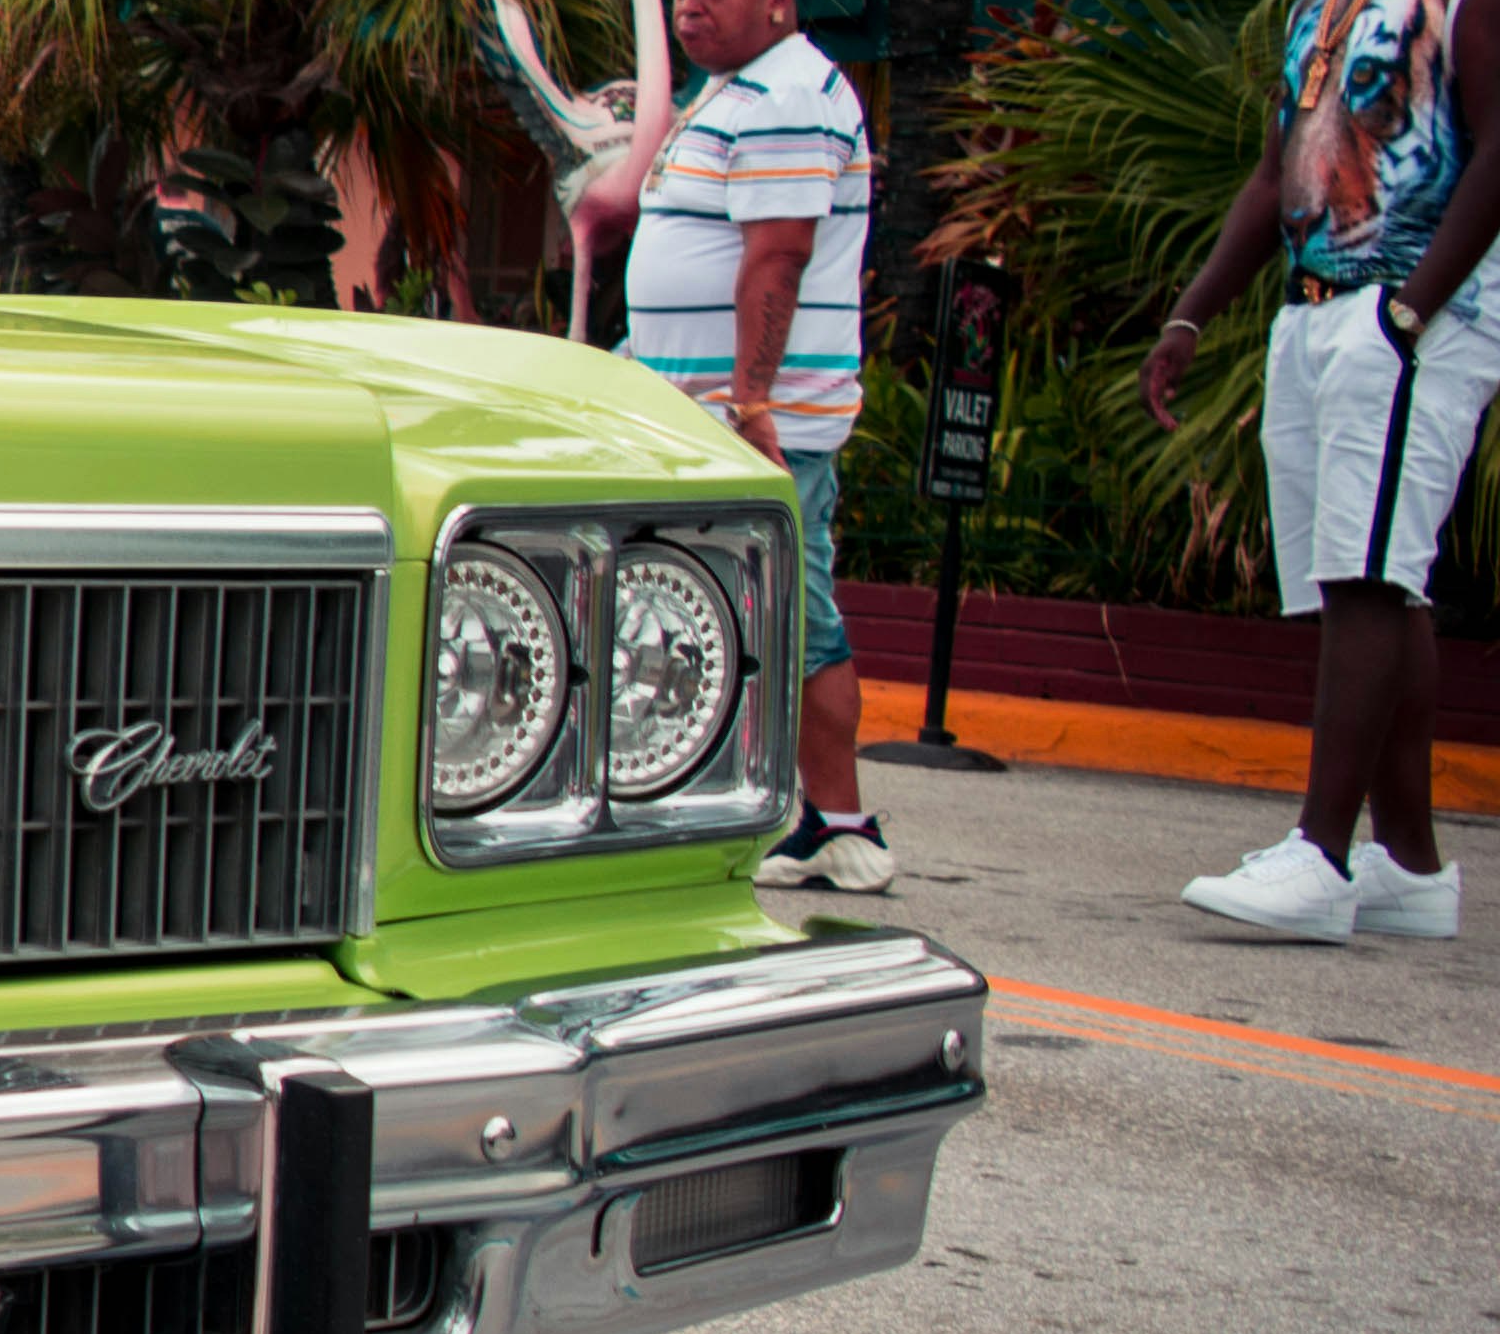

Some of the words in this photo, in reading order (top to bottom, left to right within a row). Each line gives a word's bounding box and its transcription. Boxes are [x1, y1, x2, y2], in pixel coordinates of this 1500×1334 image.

[944, 387, 992, 426] VALET
[942, 429, 986, 462] PARKING
[66, 719, 278, 811] Chevrolet
